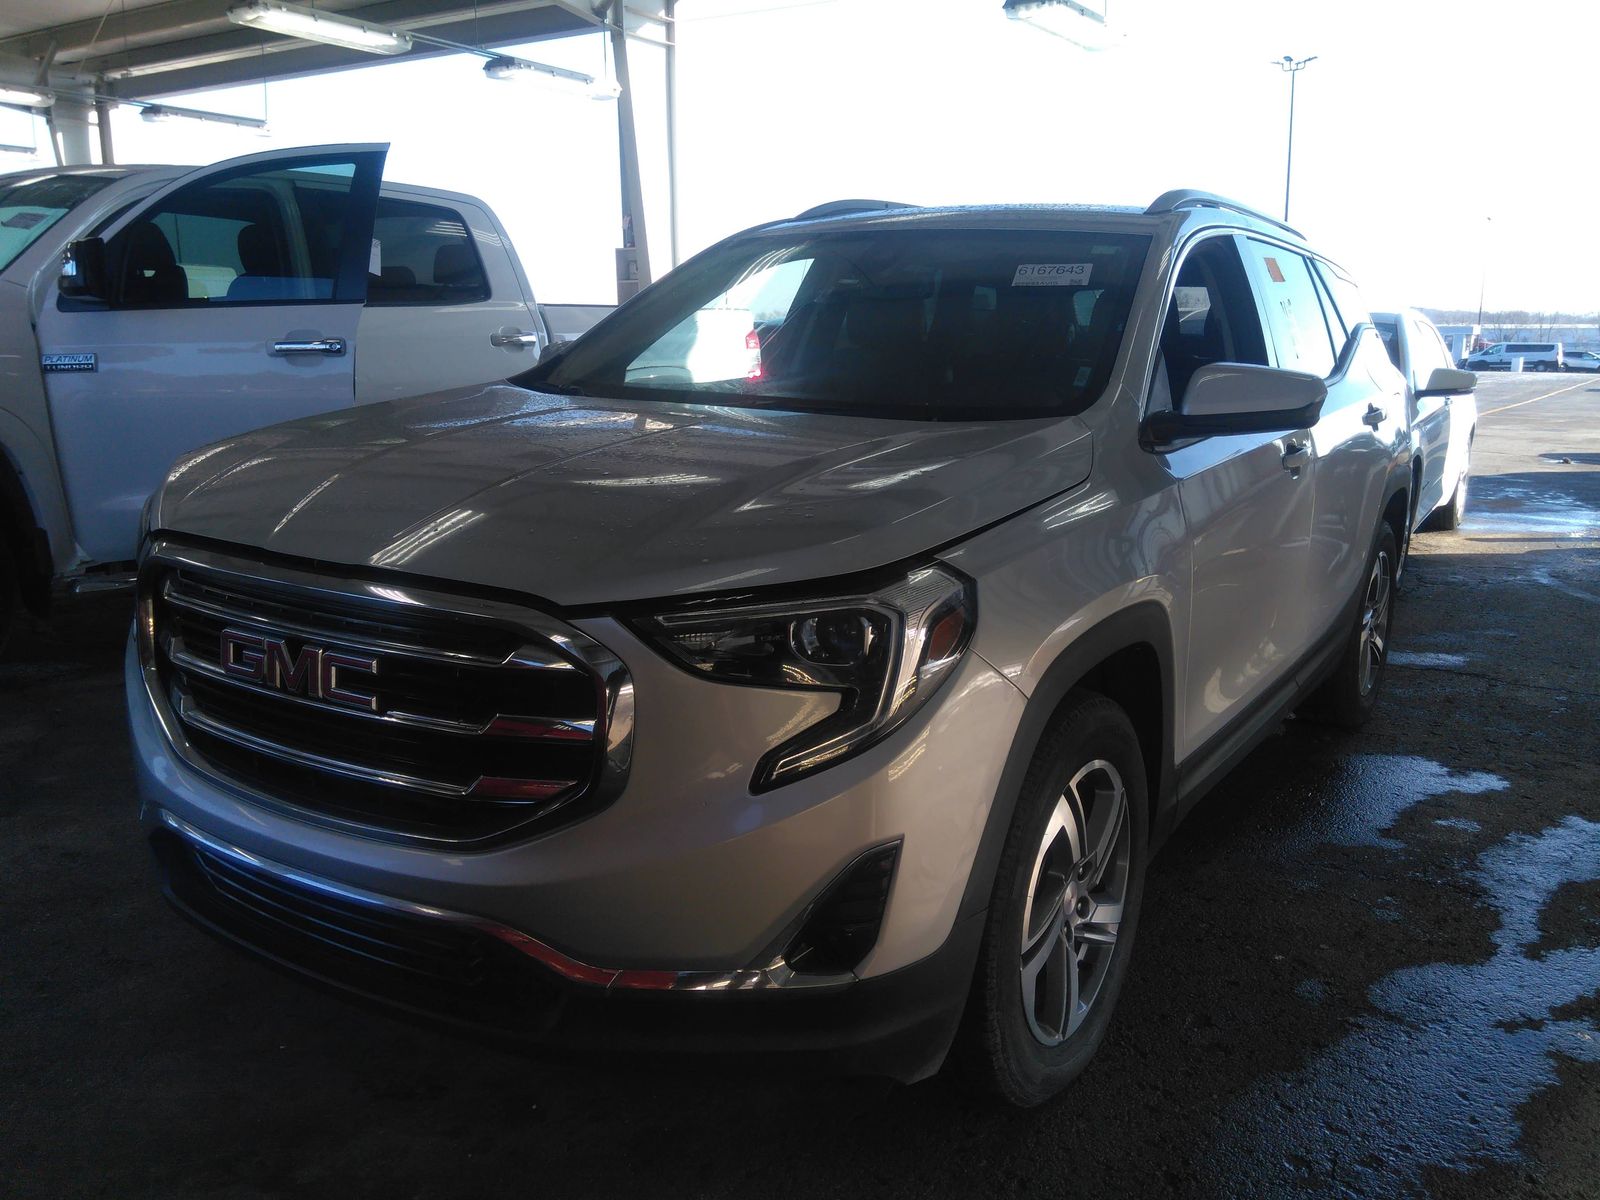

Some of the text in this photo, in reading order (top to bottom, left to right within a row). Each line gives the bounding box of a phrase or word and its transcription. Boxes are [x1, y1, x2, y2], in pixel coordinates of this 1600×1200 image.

[1018, 265, 1085, 275] 6167643
[44, 354, 93, 363] PLATINUM
[220, 627, 379, 712] GMC
